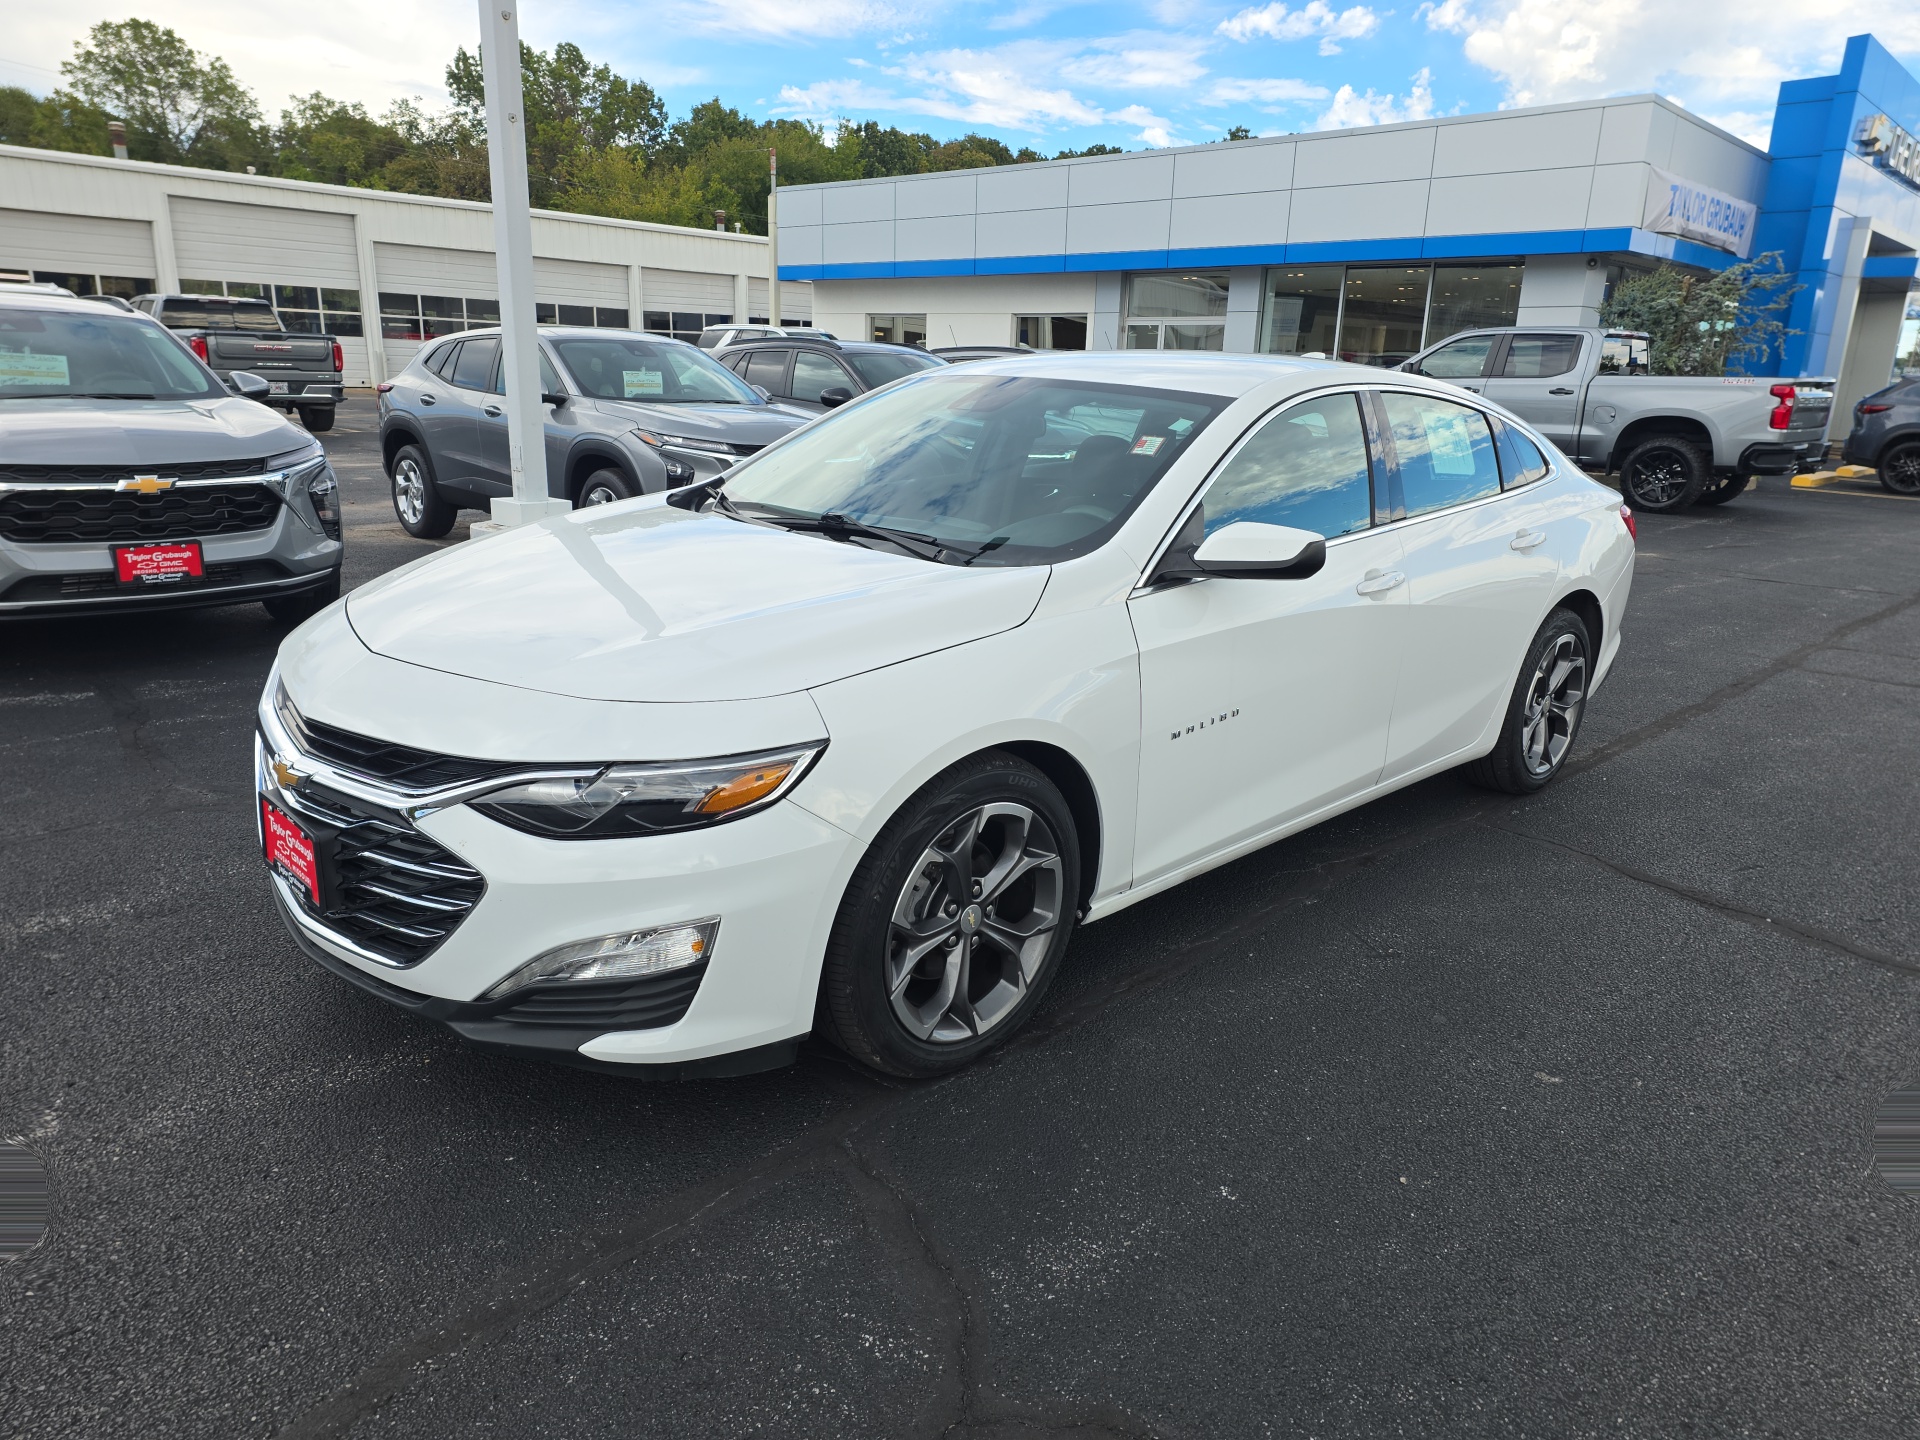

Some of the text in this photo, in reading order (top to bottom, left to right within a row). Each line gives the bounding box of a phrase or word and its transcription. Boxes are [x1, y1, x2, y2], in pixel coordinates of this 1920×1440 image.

[1668, 184, 1707, 226] TAYLOR
[124, 551, 192, 564] Taylor Grubaugh
[1008, 775, 1038, 788] UHP
[268, 814, 313, 862] Taylor Grubaugh
[291, 851, 308, 872] GMC
